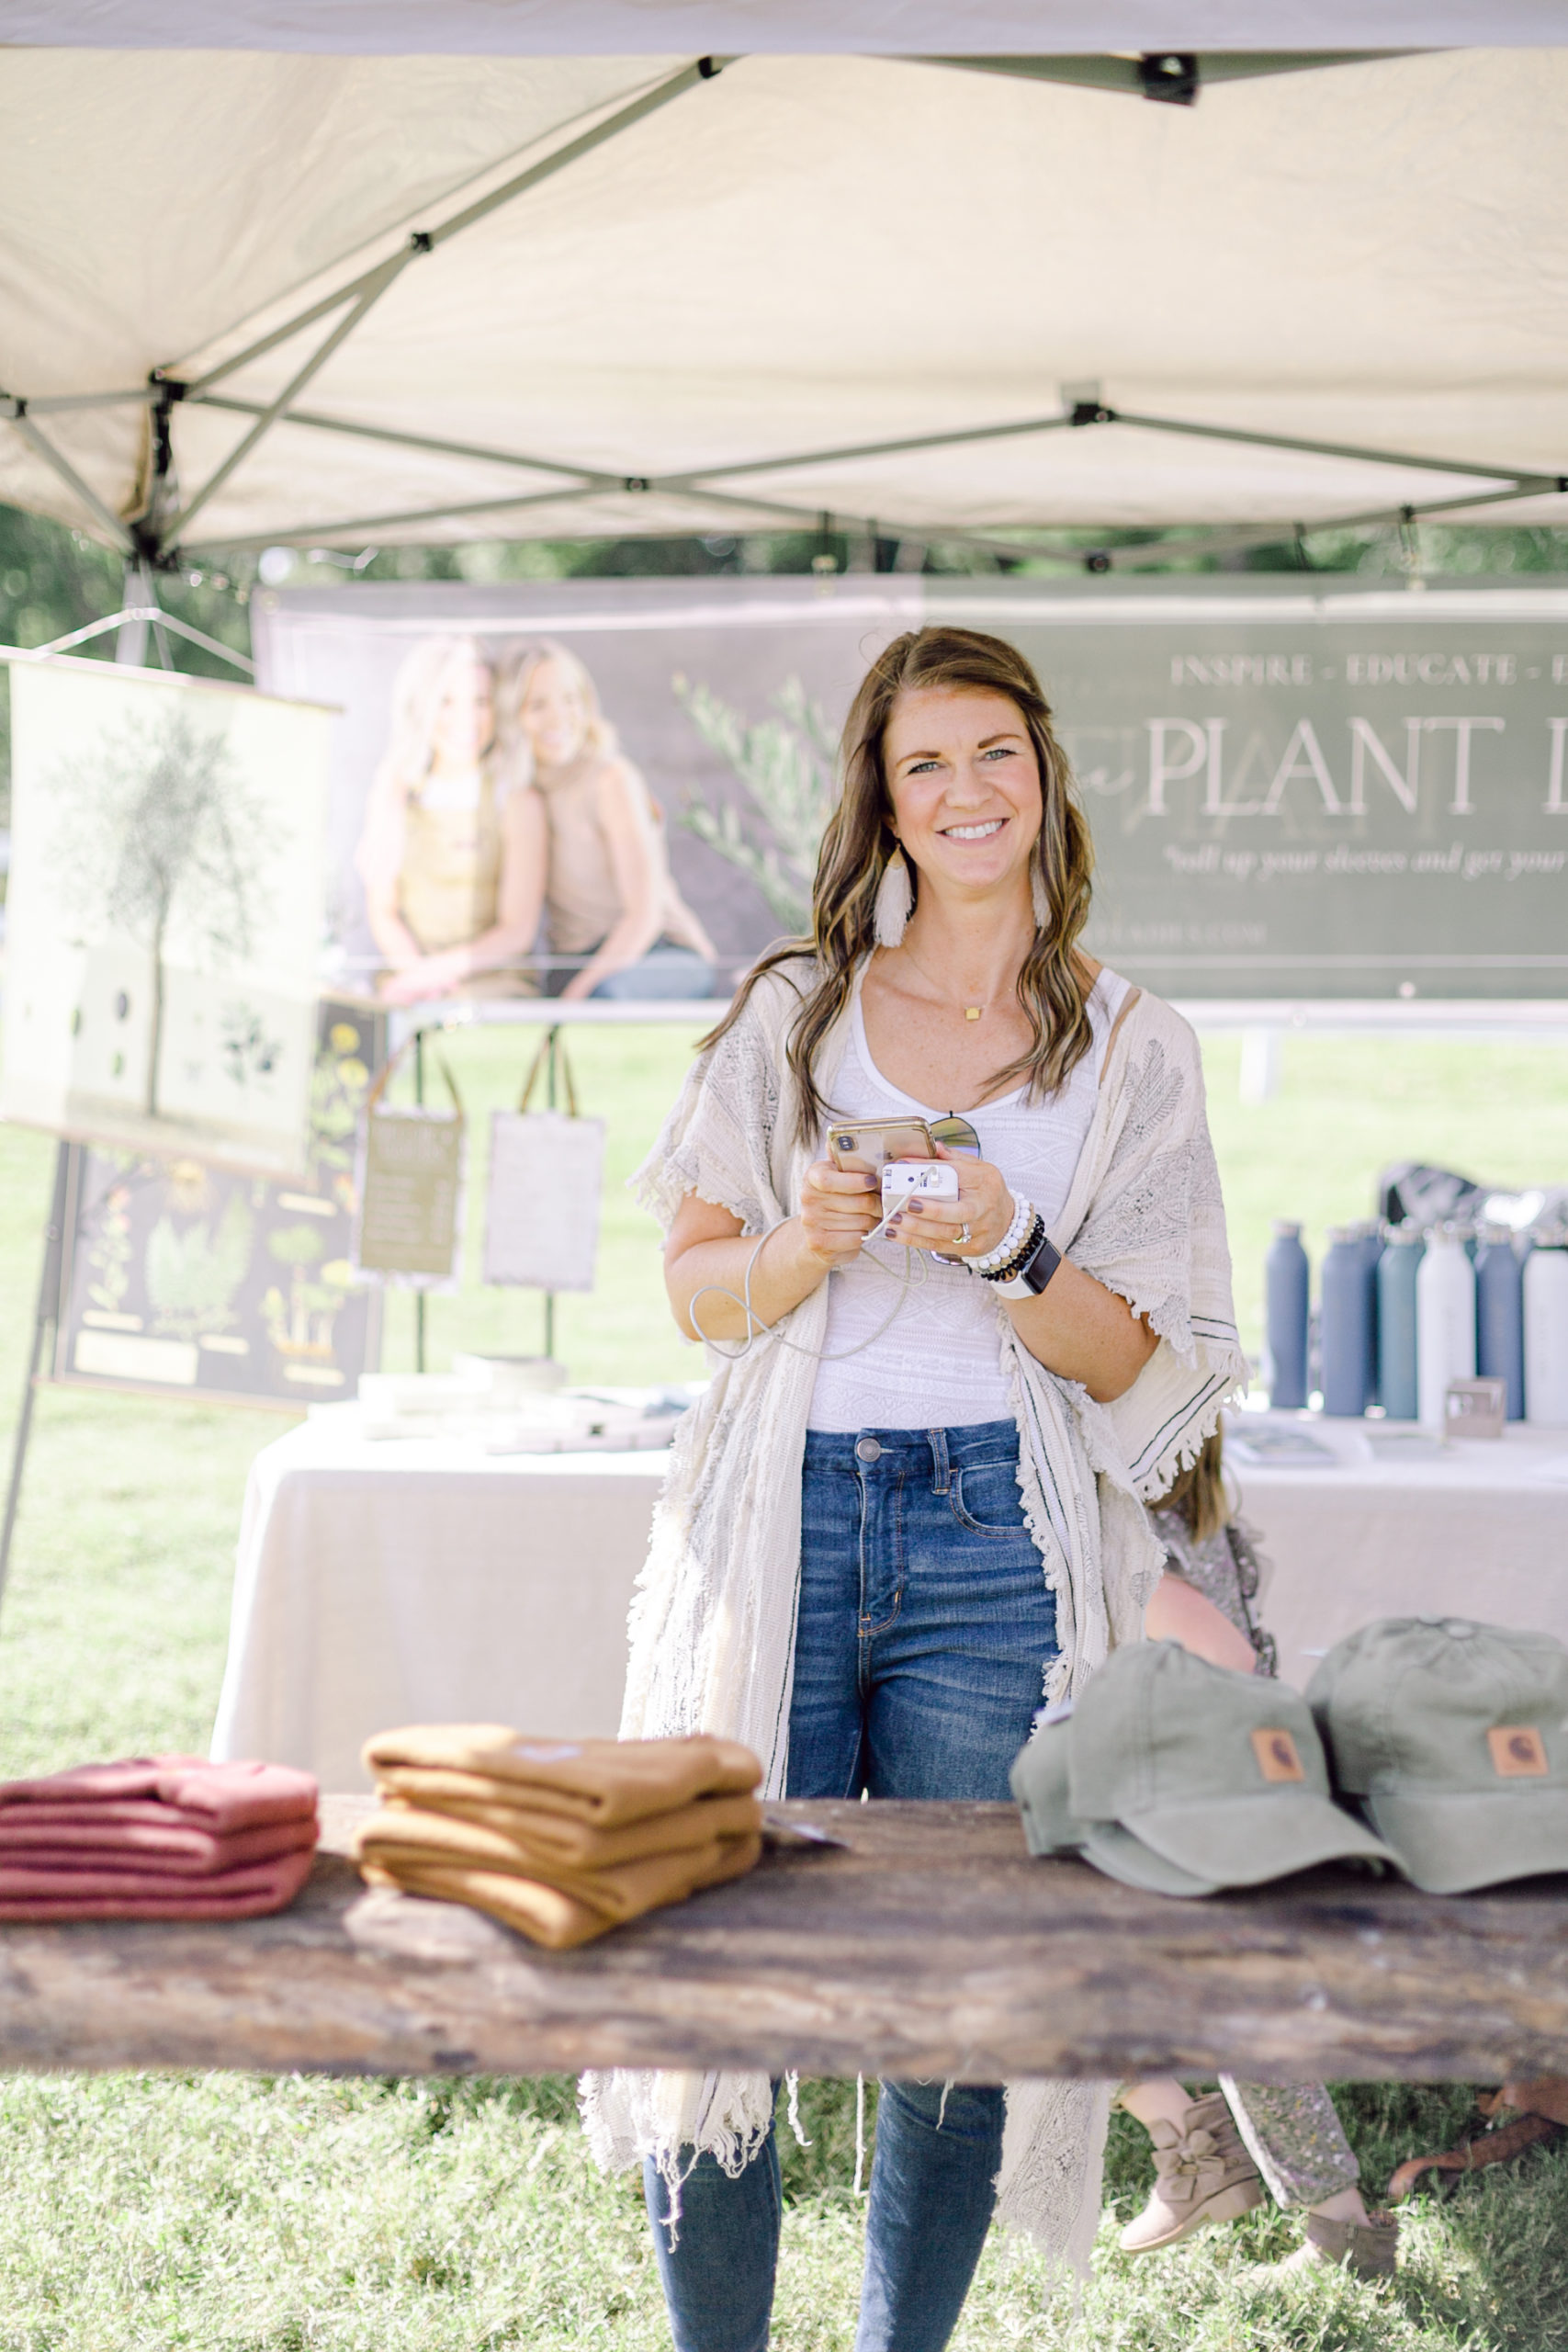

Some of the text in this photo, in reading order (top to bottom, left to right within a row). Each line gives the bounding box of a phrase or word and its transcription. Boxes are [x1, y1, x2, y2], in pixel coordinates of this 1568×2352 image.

[1170, 654, 1314, 685] INSPIRE
[1347, 653, 1517, 685] EDUCATE
[1144, 716, 1506, 816] PLANT
[1255, 851, 1317, 883] your
[1410, 840, 1464, 873] and
[1505, 850, 1566, 882] your
